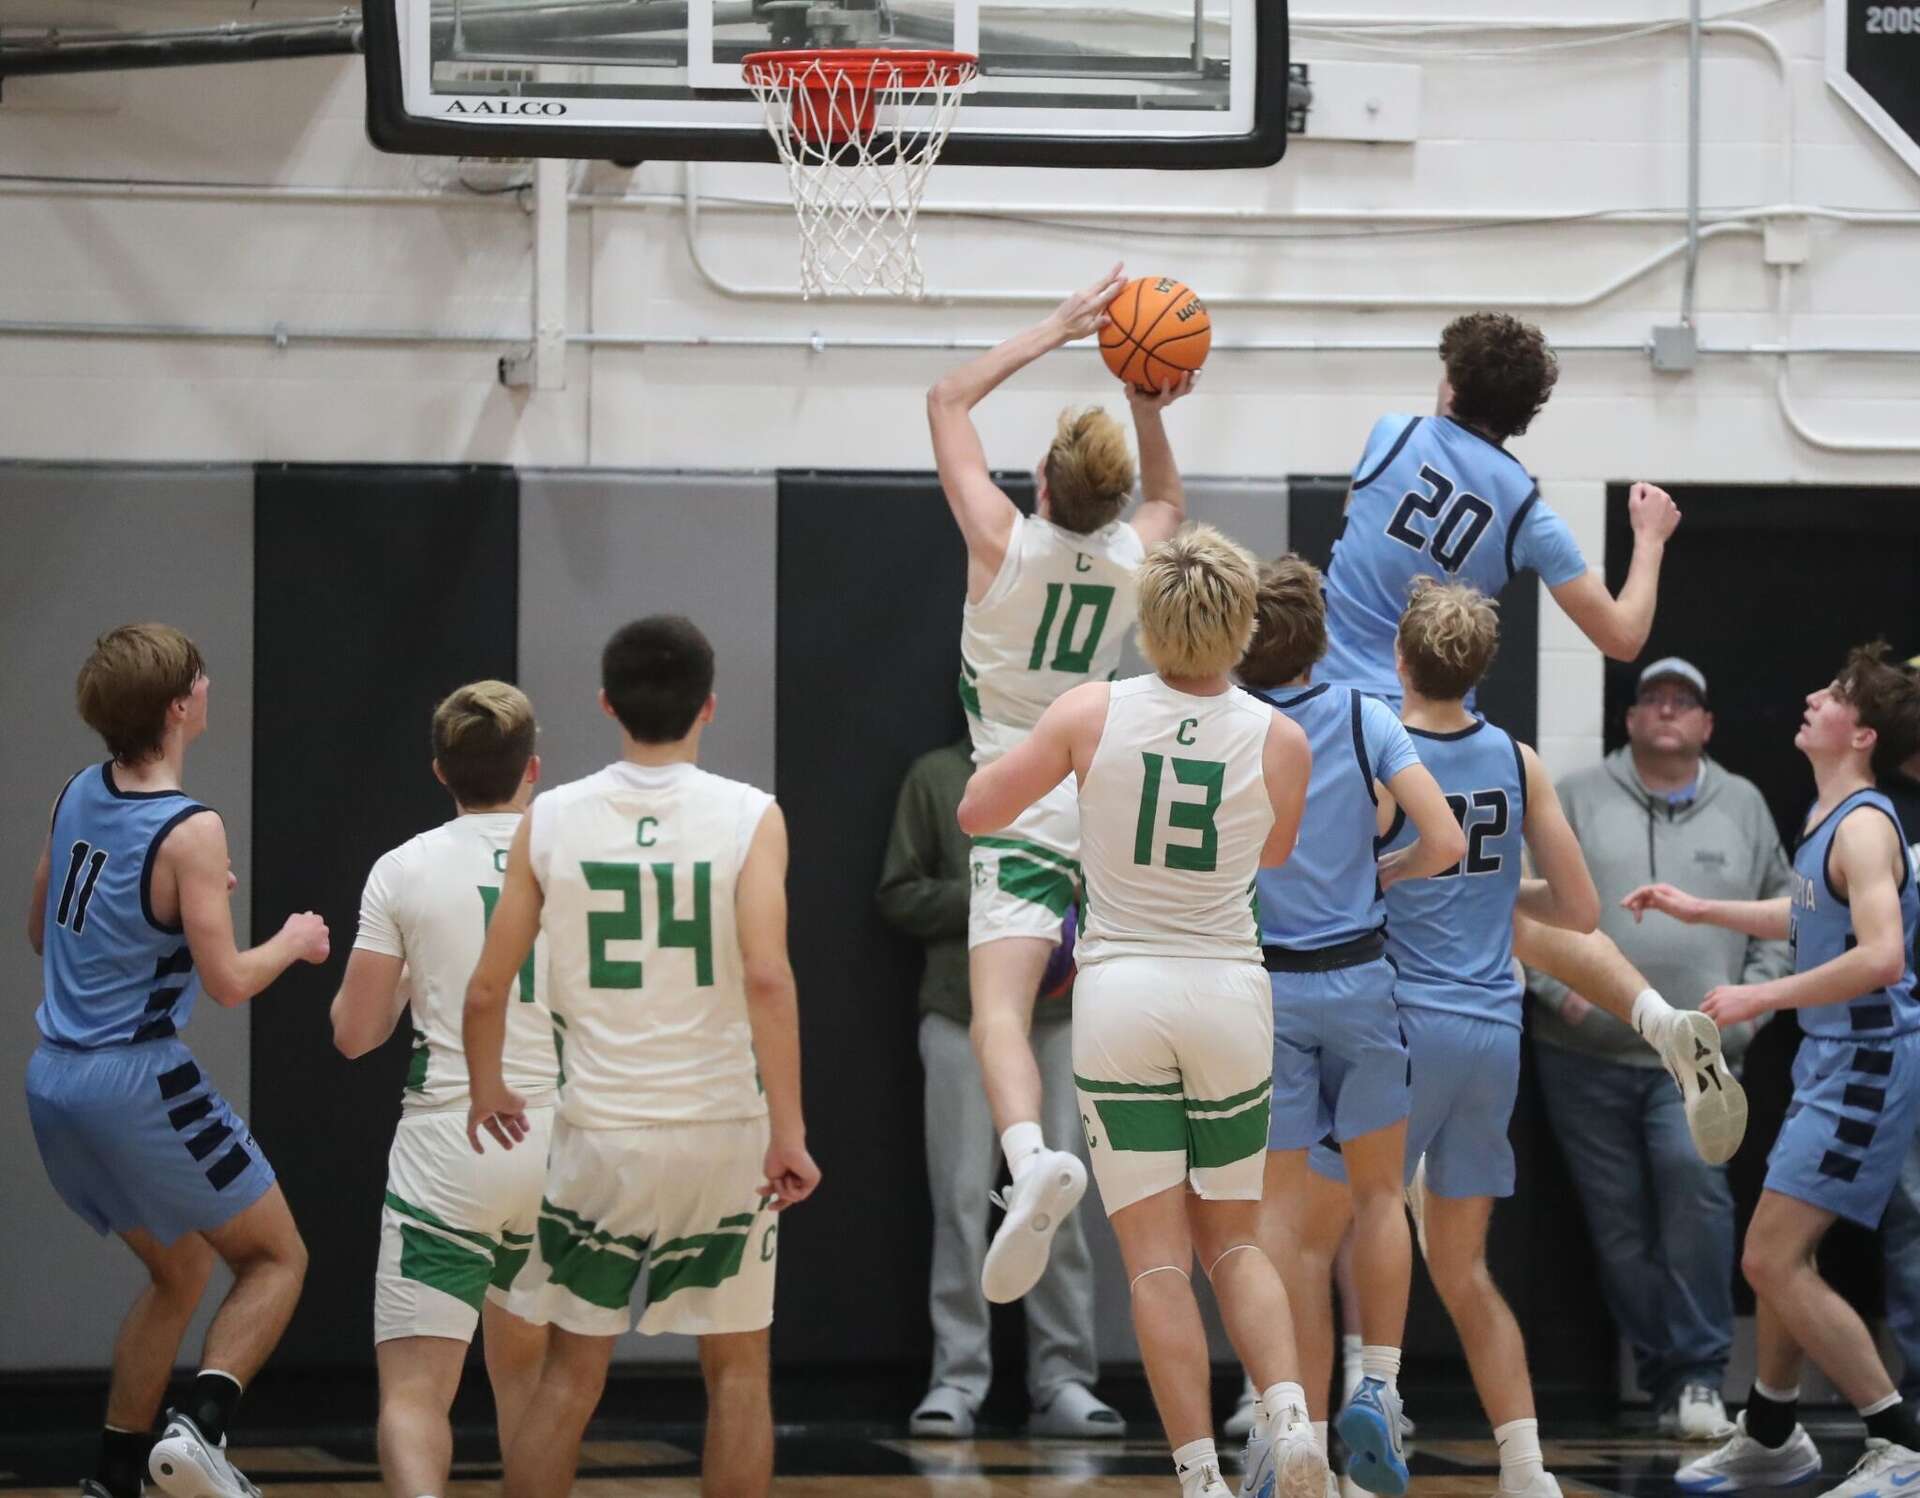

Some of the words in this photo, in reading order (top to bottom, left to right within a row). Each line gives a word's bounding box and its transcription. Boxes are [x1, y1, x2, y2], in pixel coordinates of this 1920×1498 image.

[445, 100, 567, 116] AALCO
[1384, 463, 1495, 574] 20
[1075, 552, 1093, 573] C
[1028, 583, 1116, 673] 10
[1176, 718, 1198, 746] C
[1134, 751, 1226, 872] 13
[635, 816, 659, 848] C
[56, 840, 109, 936] 11
[579, 861, 714, 989] 24
[1082, 1113, 1097, 1148] C
[761, 1224, 776, 1262] C
